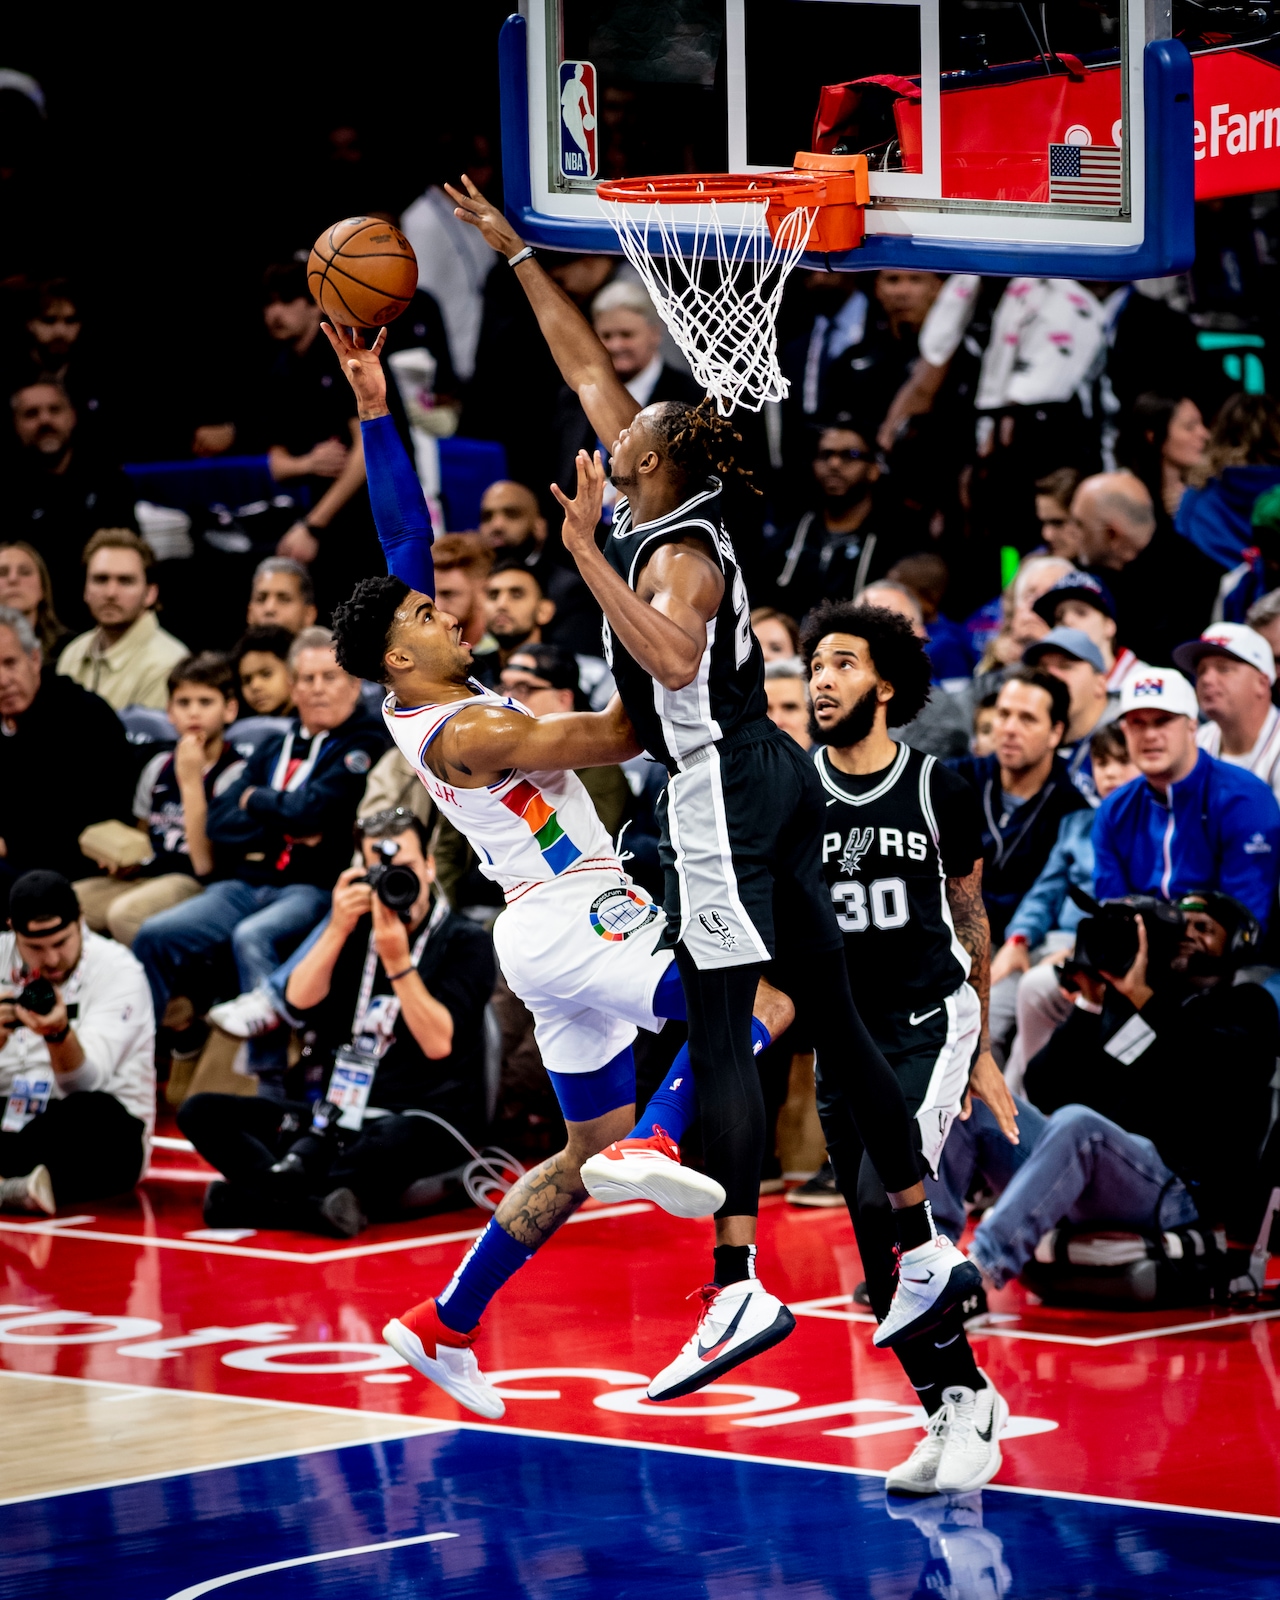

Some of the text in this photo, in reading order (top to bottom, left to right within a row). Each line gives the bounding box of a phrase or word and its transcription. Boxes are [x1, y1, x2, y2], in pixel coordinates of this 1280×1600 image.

[565, 152, 583, 171] NBA
[822, 827, 927, 876] PURS
[830, 877, 910, 932] 30
